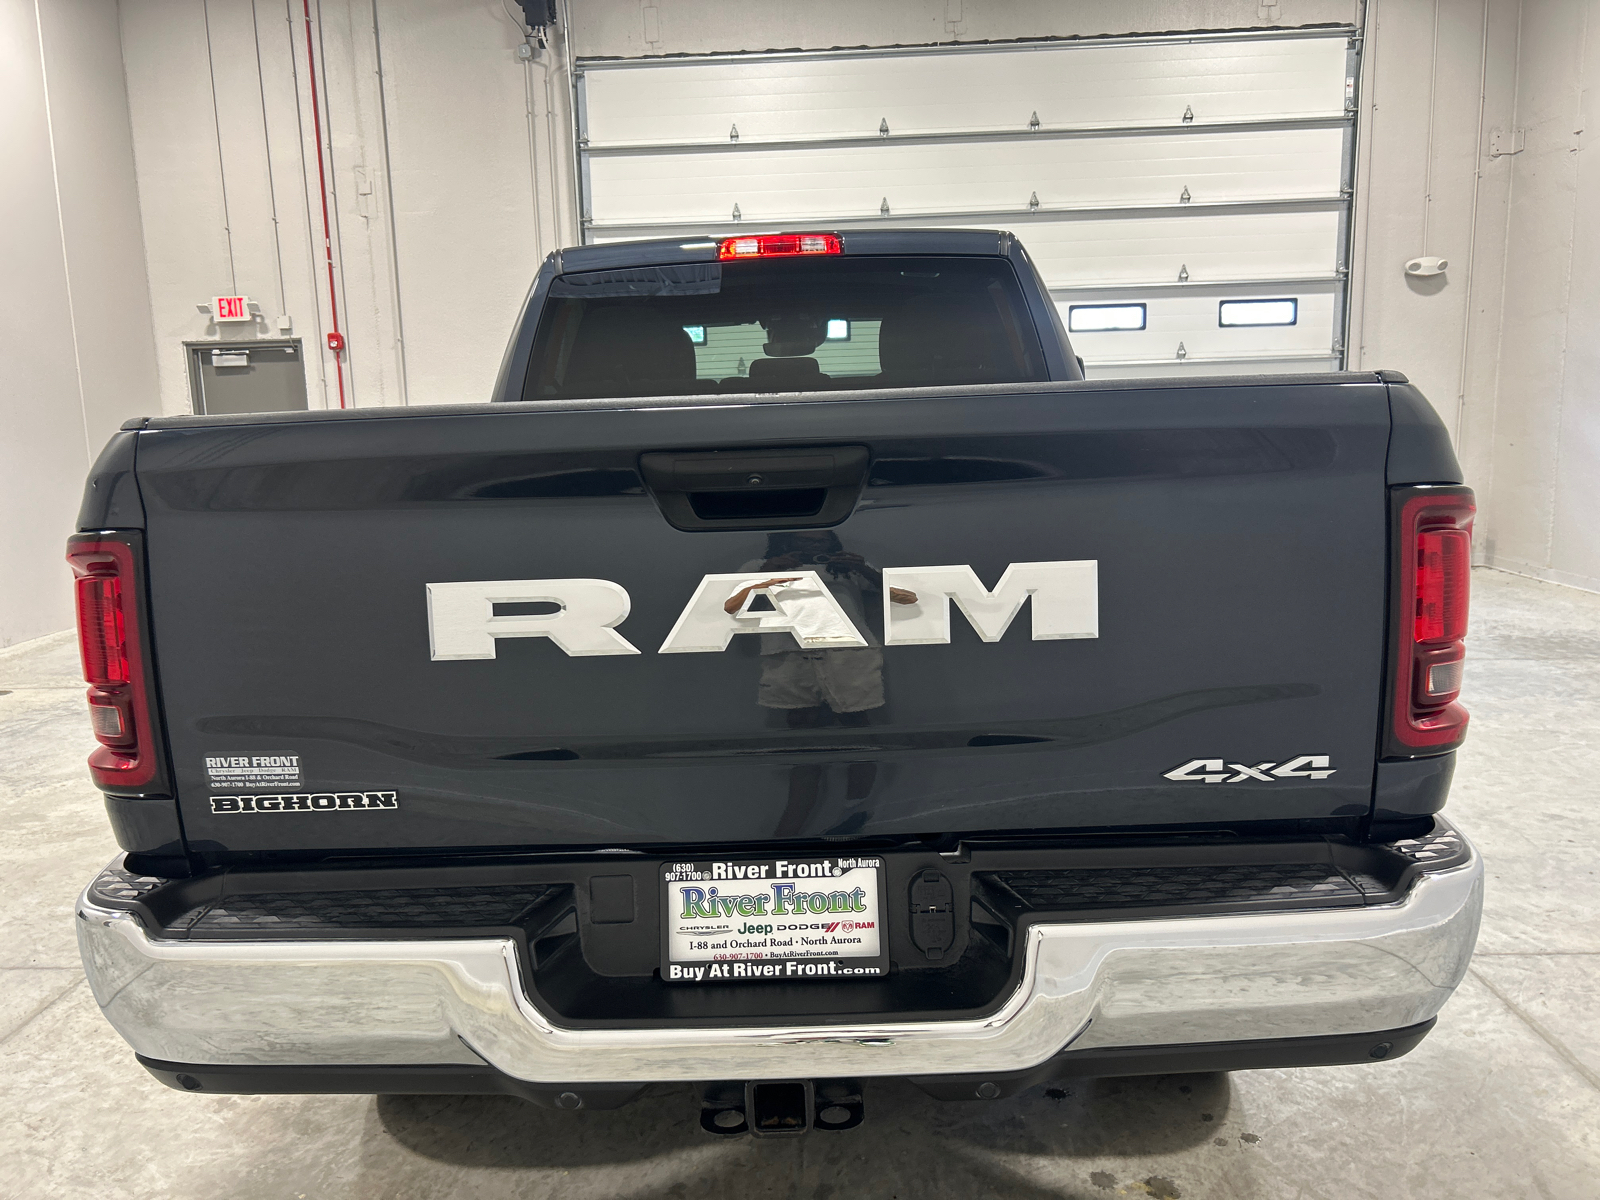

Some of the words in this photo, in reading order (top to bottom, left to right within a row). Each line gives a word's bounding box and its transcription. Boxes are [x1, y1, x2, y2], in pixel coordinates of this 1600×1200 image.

[218, 297, 244, 318] EXIT
[425, 559, 1099, 662] RAM
[205, 757, 250, 768] RIVER
[251, 756, 299, 767] FRONT
[1162, 754, 1338, 783] 4x4
[210, 791, 398, 814] BIGHORN
[672, 863, 694, 873] (630)
[712, 862, 769, 880] River
[775, 860, 832, 878] Front
[838, 858, 857, 868] North
[857, 858, 880, 868] Aurora
[665, 871, 702, 882] 907-1700
[680, 886, 771, 919] River
[771, 882, 867, 915] Front
[737, 922, 773, 936] Jeep
[776, 923, 830, 931] DODGE
[855, 921, 875, 930] RAM
[689, 940, 709, 950] I-88
[710, 940, 728, 949] and
[730, 938, 767, 948] Orchard
[770, 937, 793, 947] Road
[800, 935, 828, 946] North
[829, 935, 862, 945] Aurora
[713, 952, 763, 960] 630-907-1700
[770, 949, 839, 959] BuyAtRiverFront.com
[669, 964, 705, 981] Buy
[709, 963, 730, 978] At
[733, 961, 782, 977] River
